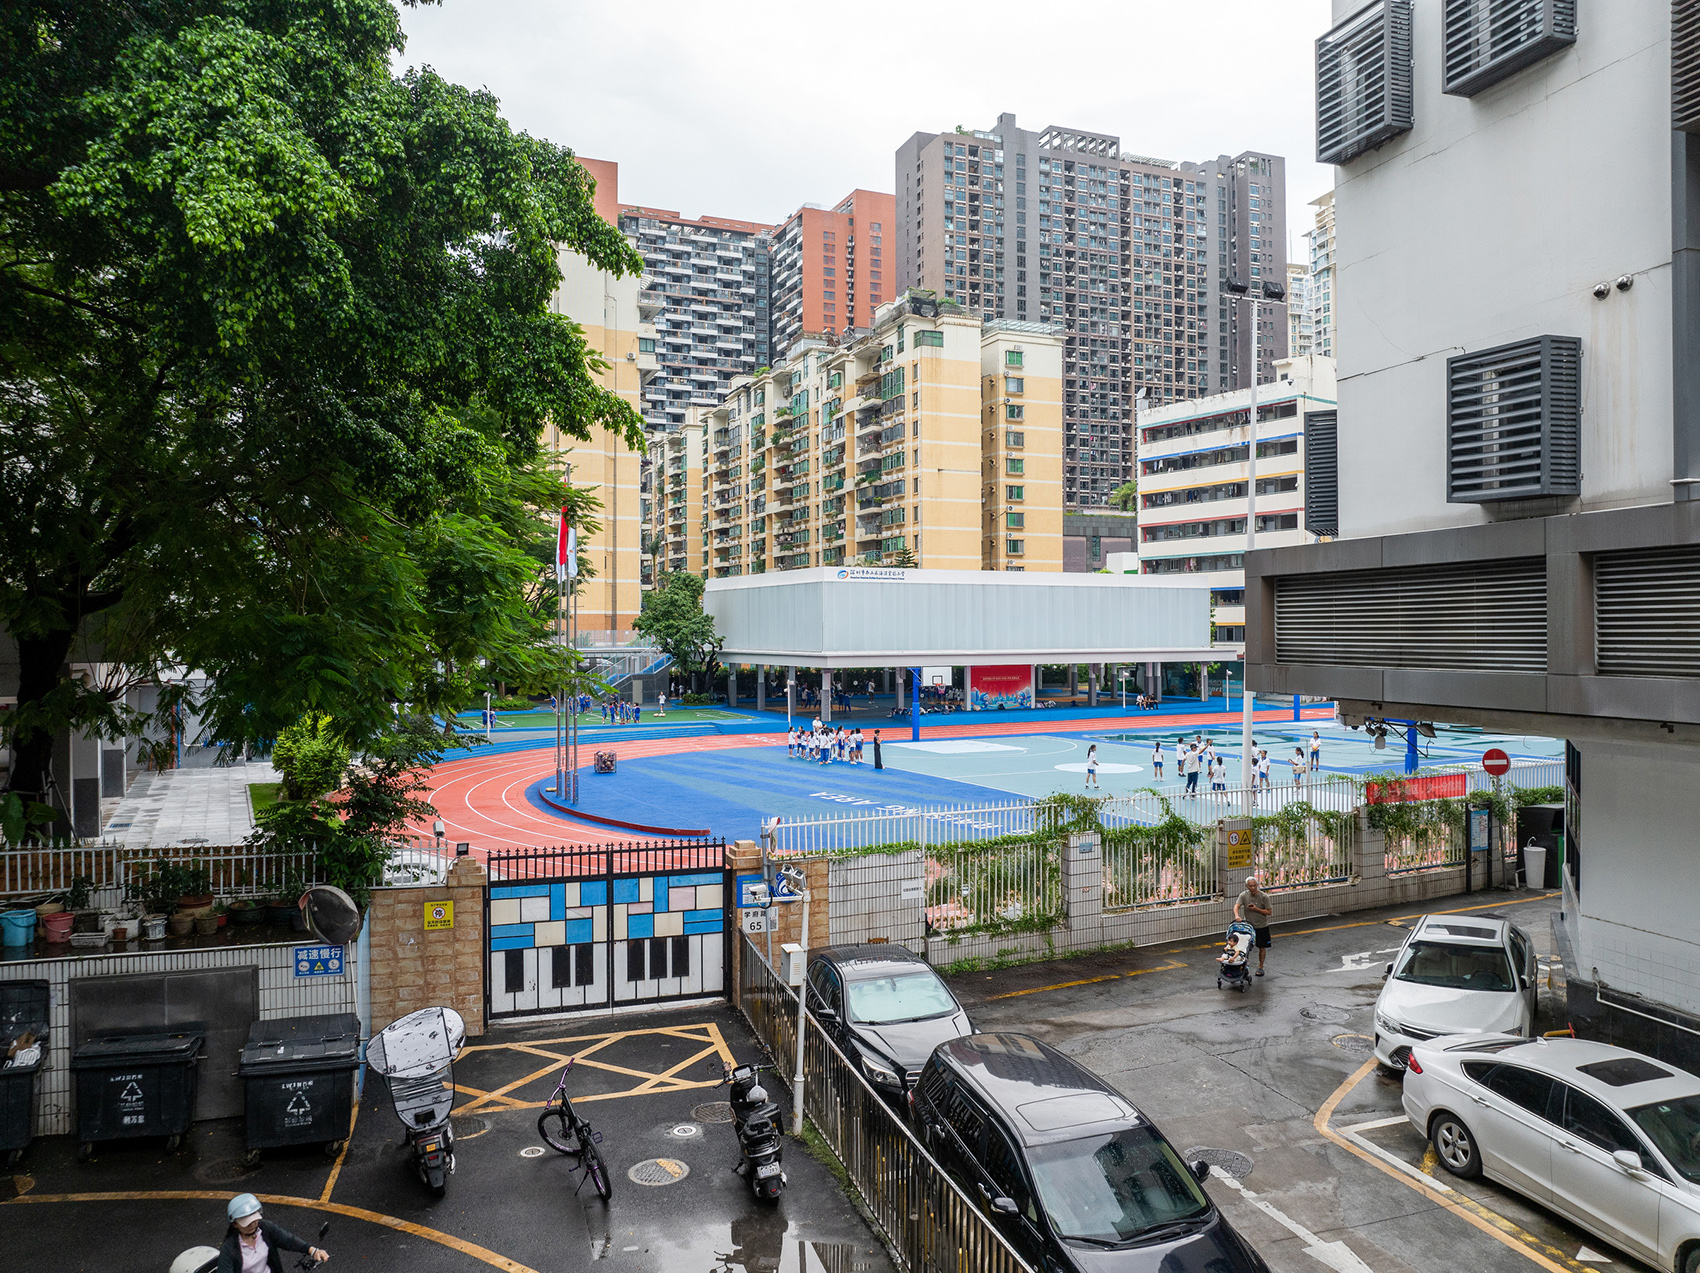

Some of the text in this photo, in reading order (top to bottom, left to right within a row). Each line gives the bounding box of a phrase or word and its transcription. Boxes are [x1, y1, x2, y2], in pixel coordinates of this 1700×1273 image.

[744, 910, 767, 919] 学府路
[749, 921, 762, 931] 65
[297, 947, 342, 960] 减速慢行
